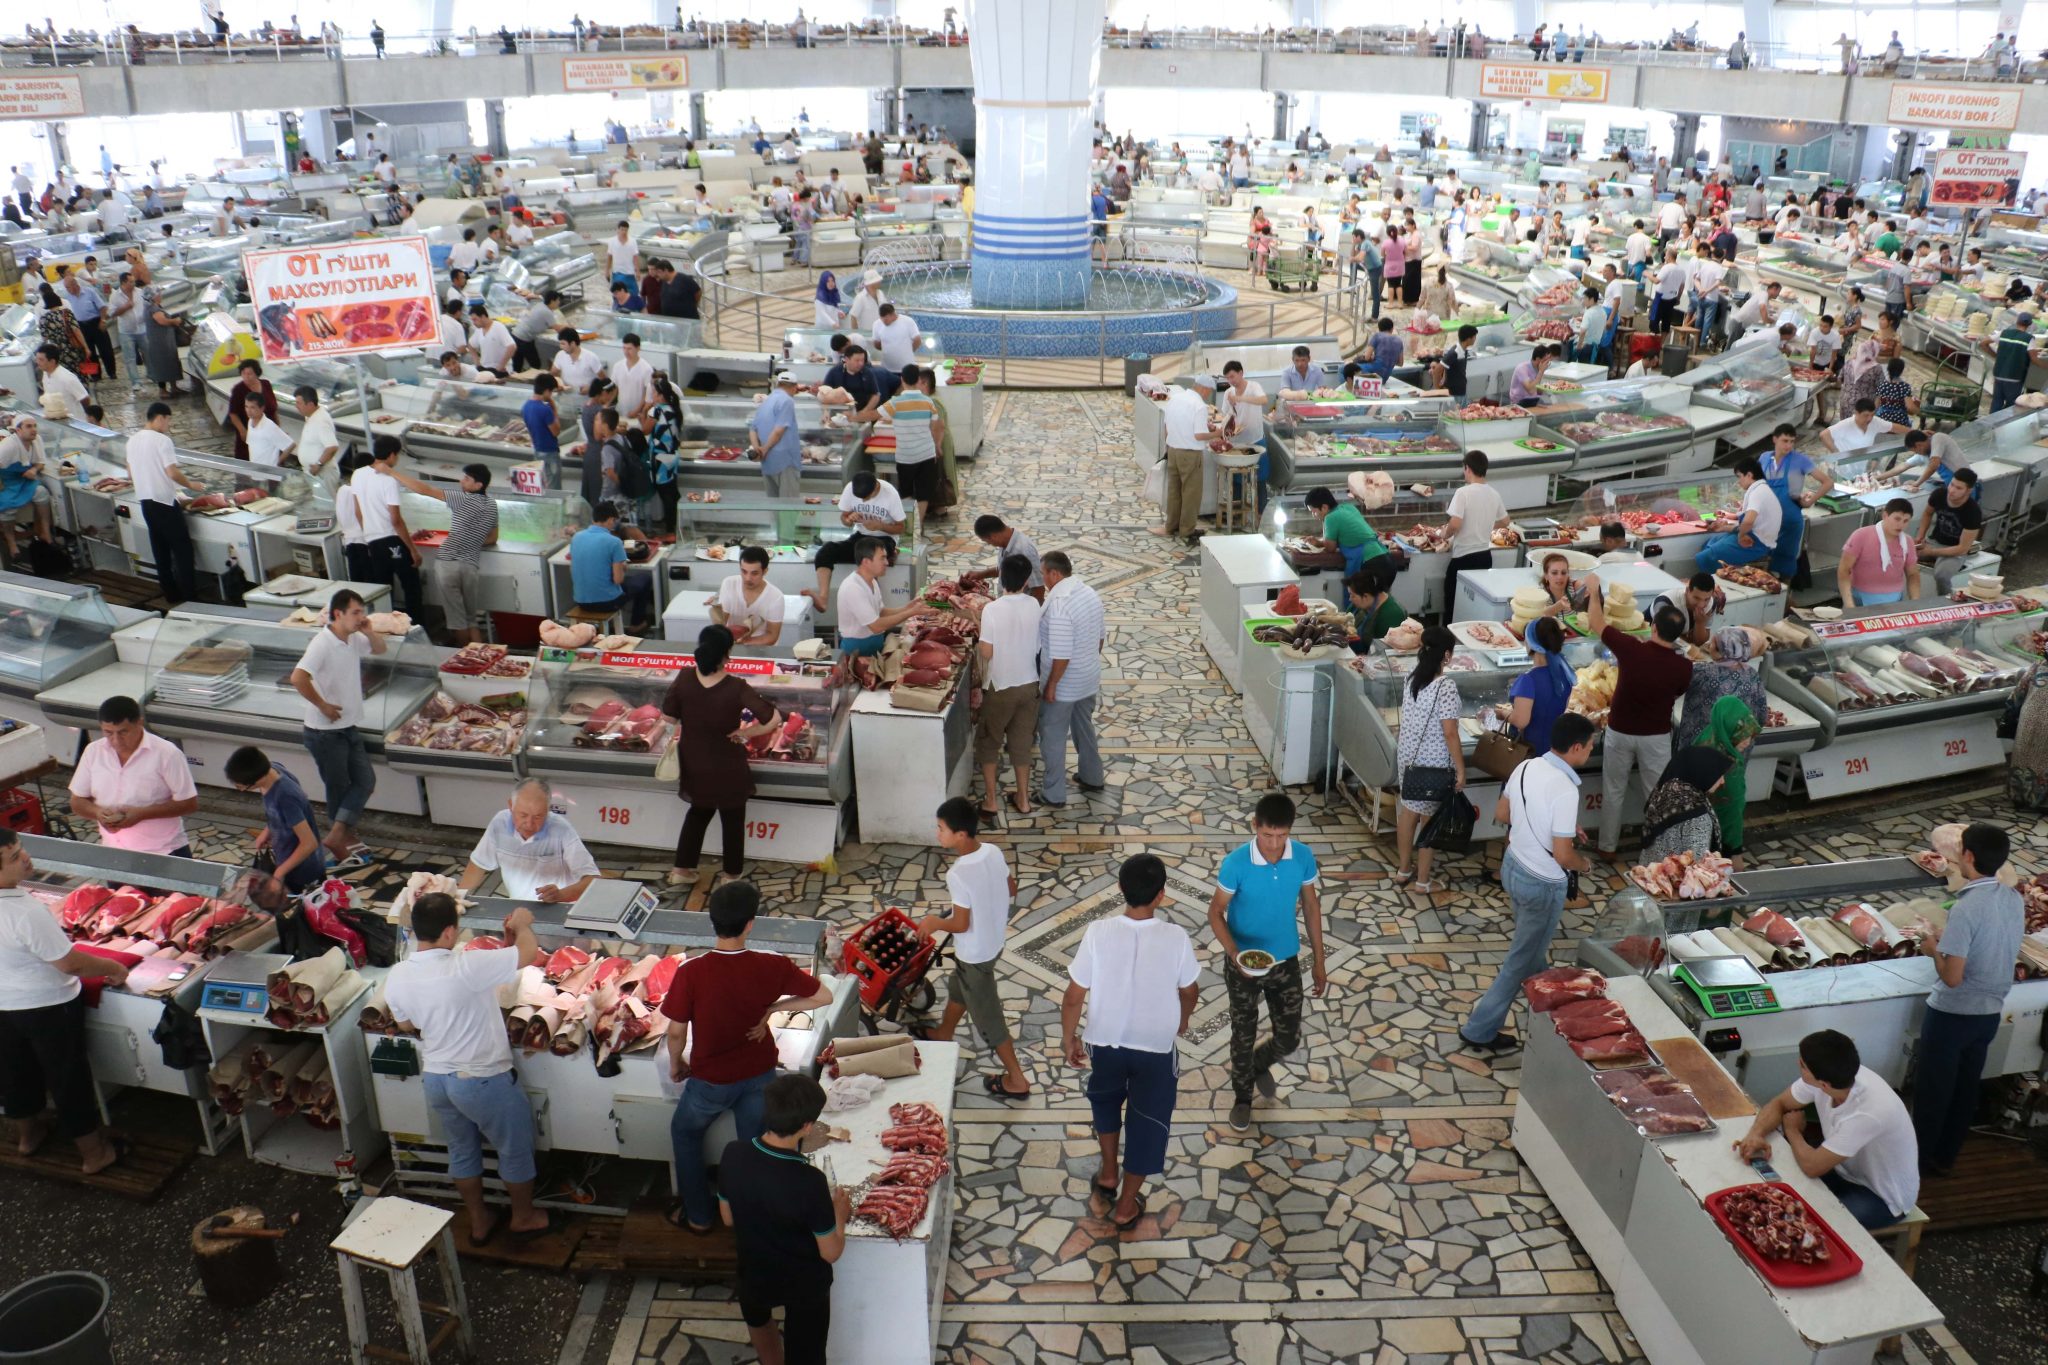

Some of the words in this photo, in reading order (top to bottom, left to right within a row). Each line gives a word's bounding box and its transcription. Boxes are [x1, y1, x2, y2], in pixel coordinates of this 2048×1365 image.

[1908, 92, 1945, 103] INSOFI
[1947, 95, 2000, 107] BORNING
[1907, 107, 1962, 120] BARAKASI
[1964, 110, 1988, 121] BOR
[1957, 153, 1975, 165] ОТ
[1943, 167, 2018, 177] МАХСУЛОТЛАРИ
[287, 253, 321, 277] ОТ
[326, 253, 390, 274] ГЎШТИ
[268, 272, 418, 301] МАХСУЛОТЛАРИ
[1362, 380, 1381, 391] ОТ
[518, 470, 536, 484] ОТ
[1863, 618, 1884, 631] МОЛ
[611, 655, 634, 664] МОЛ
[1944, 739, 1968, 756] 292
[1845, 757, 1869, 775] 291
[598, 806, 630, 825] 198
[746, 821, 779, 840] 197
